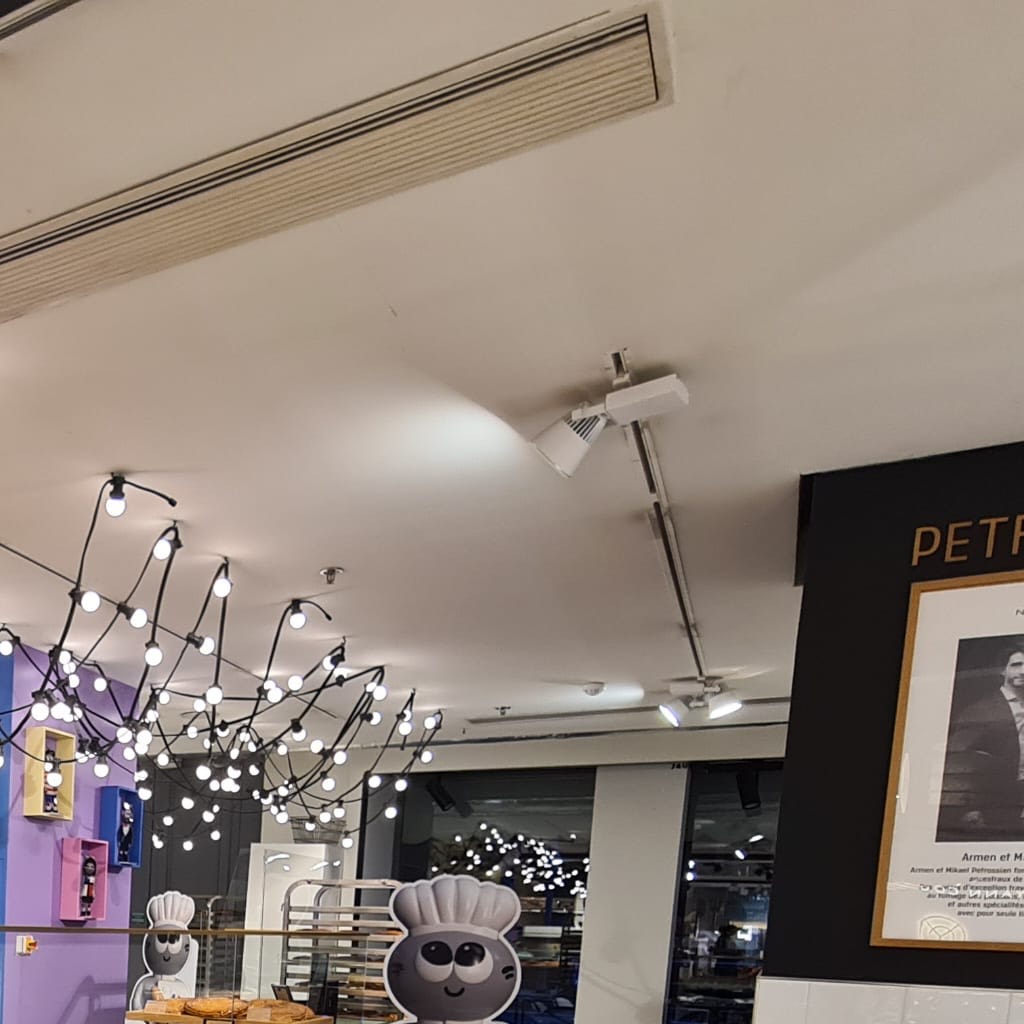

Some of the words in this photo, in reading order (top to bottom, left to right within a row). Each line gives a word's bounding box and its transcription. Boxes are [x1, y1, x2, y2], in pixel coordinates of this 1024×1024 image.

[962, 852, 997, 862] Armen
[999, 852, 1011, 862] et
[910, 866, 935, 874] Armen
[935, 866, 944, 874] et
